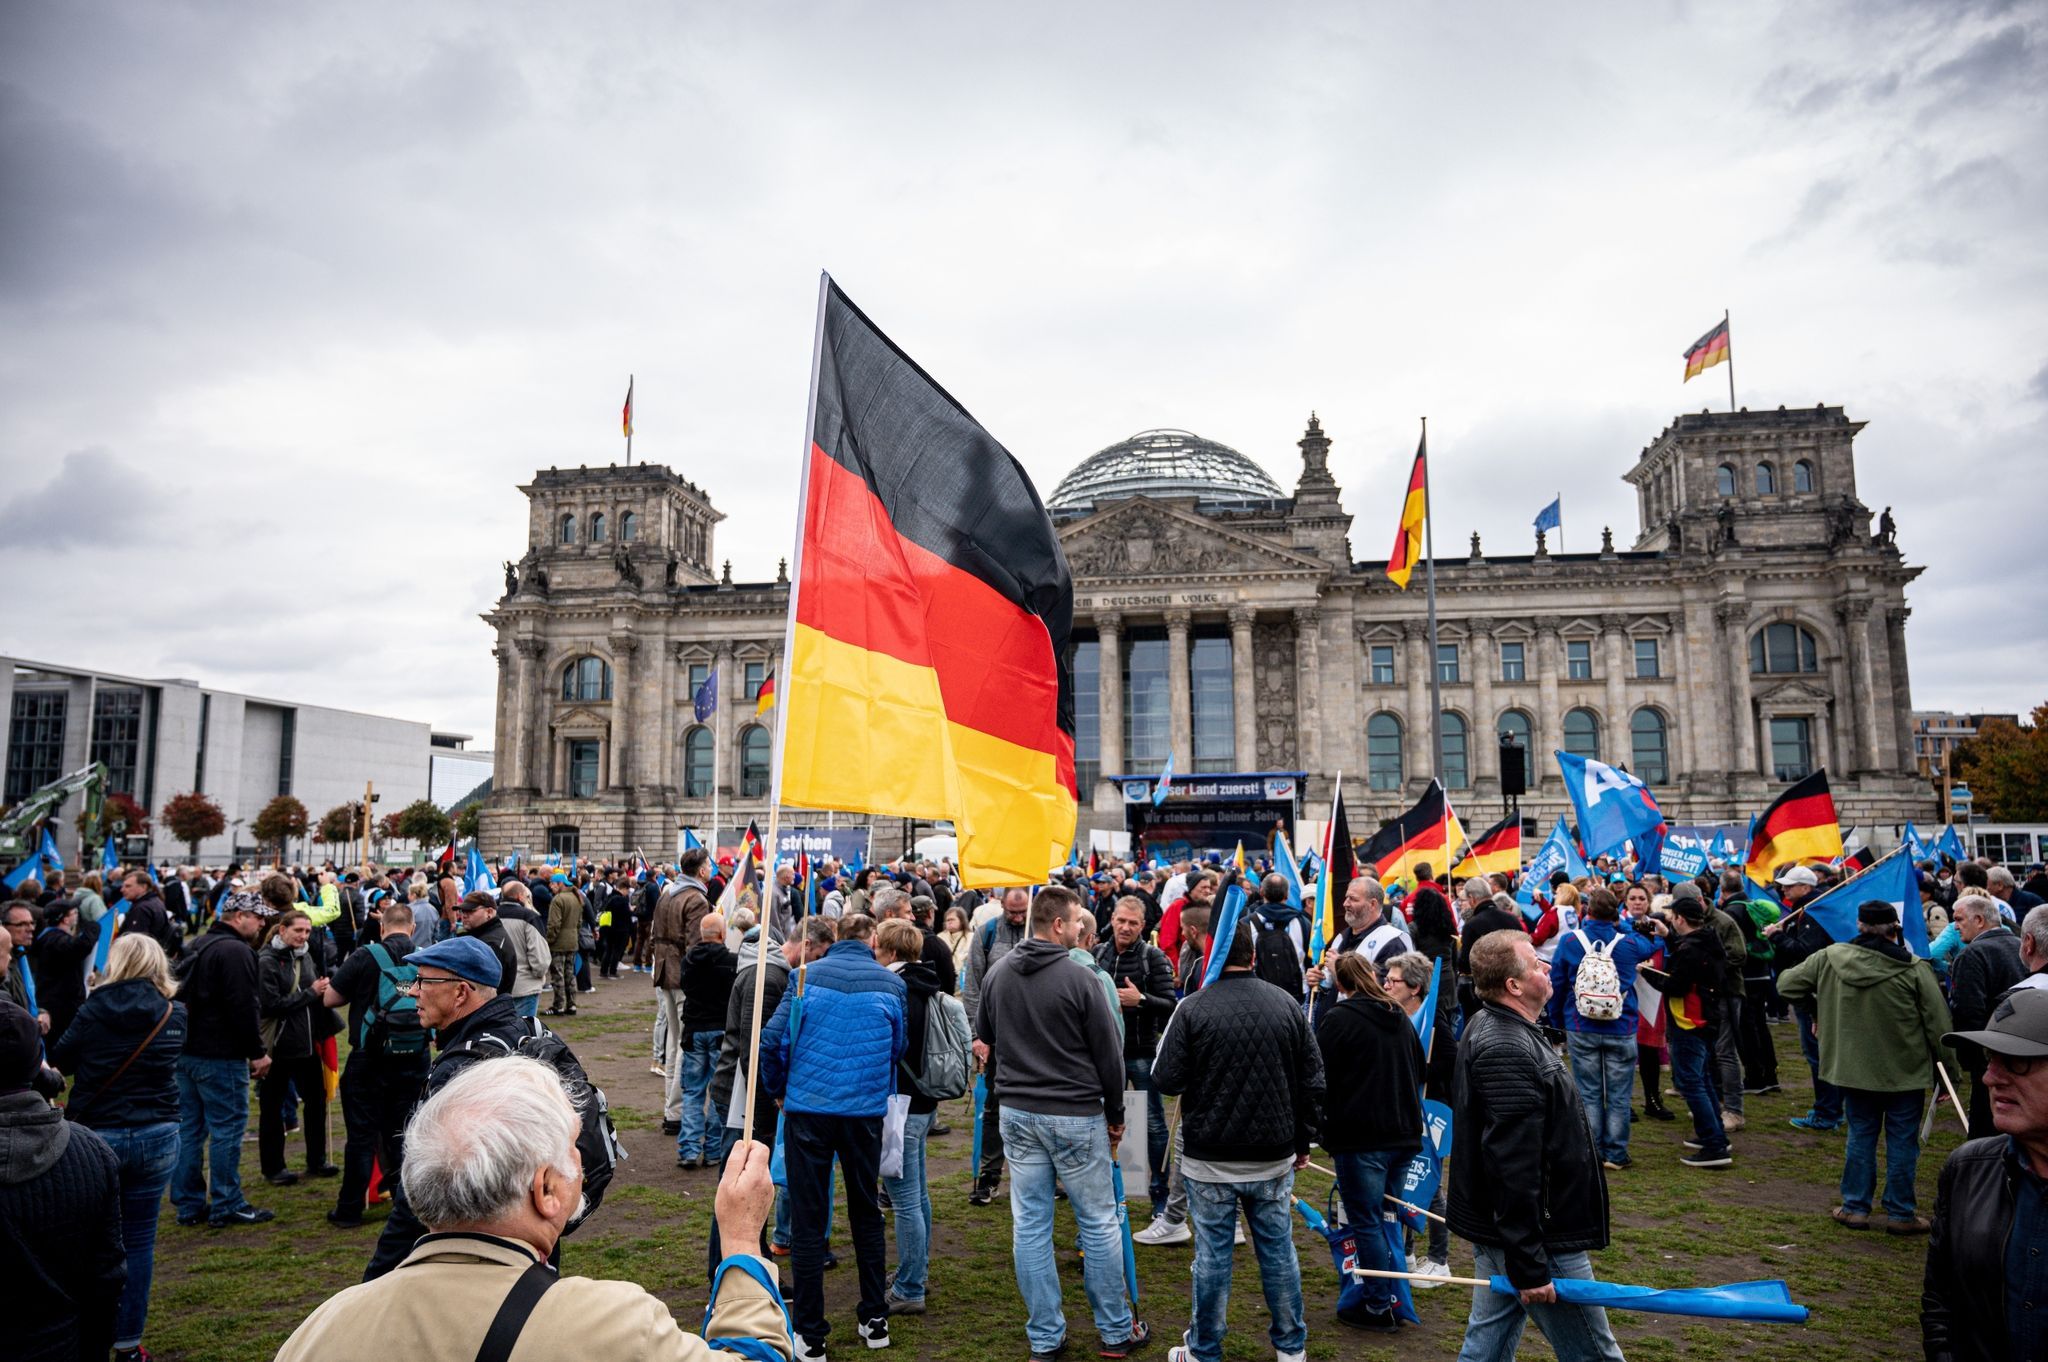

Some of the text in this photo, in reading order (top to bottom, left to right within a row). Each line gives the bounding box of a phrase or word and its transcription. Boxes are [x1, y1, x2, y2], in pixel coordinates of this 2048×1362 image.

[1075, 598, 1093, 607] EM
[1189, 783, 1217, 796] Land
[1219, 782, 1260, 796] zuerst!
[1143, 809, 1281, 824] Wir stehen an Deiner Seite
[1661, 847, 1703, 864] UNSER LAND
[1660, 855, 1700, 874] ZUERST!
